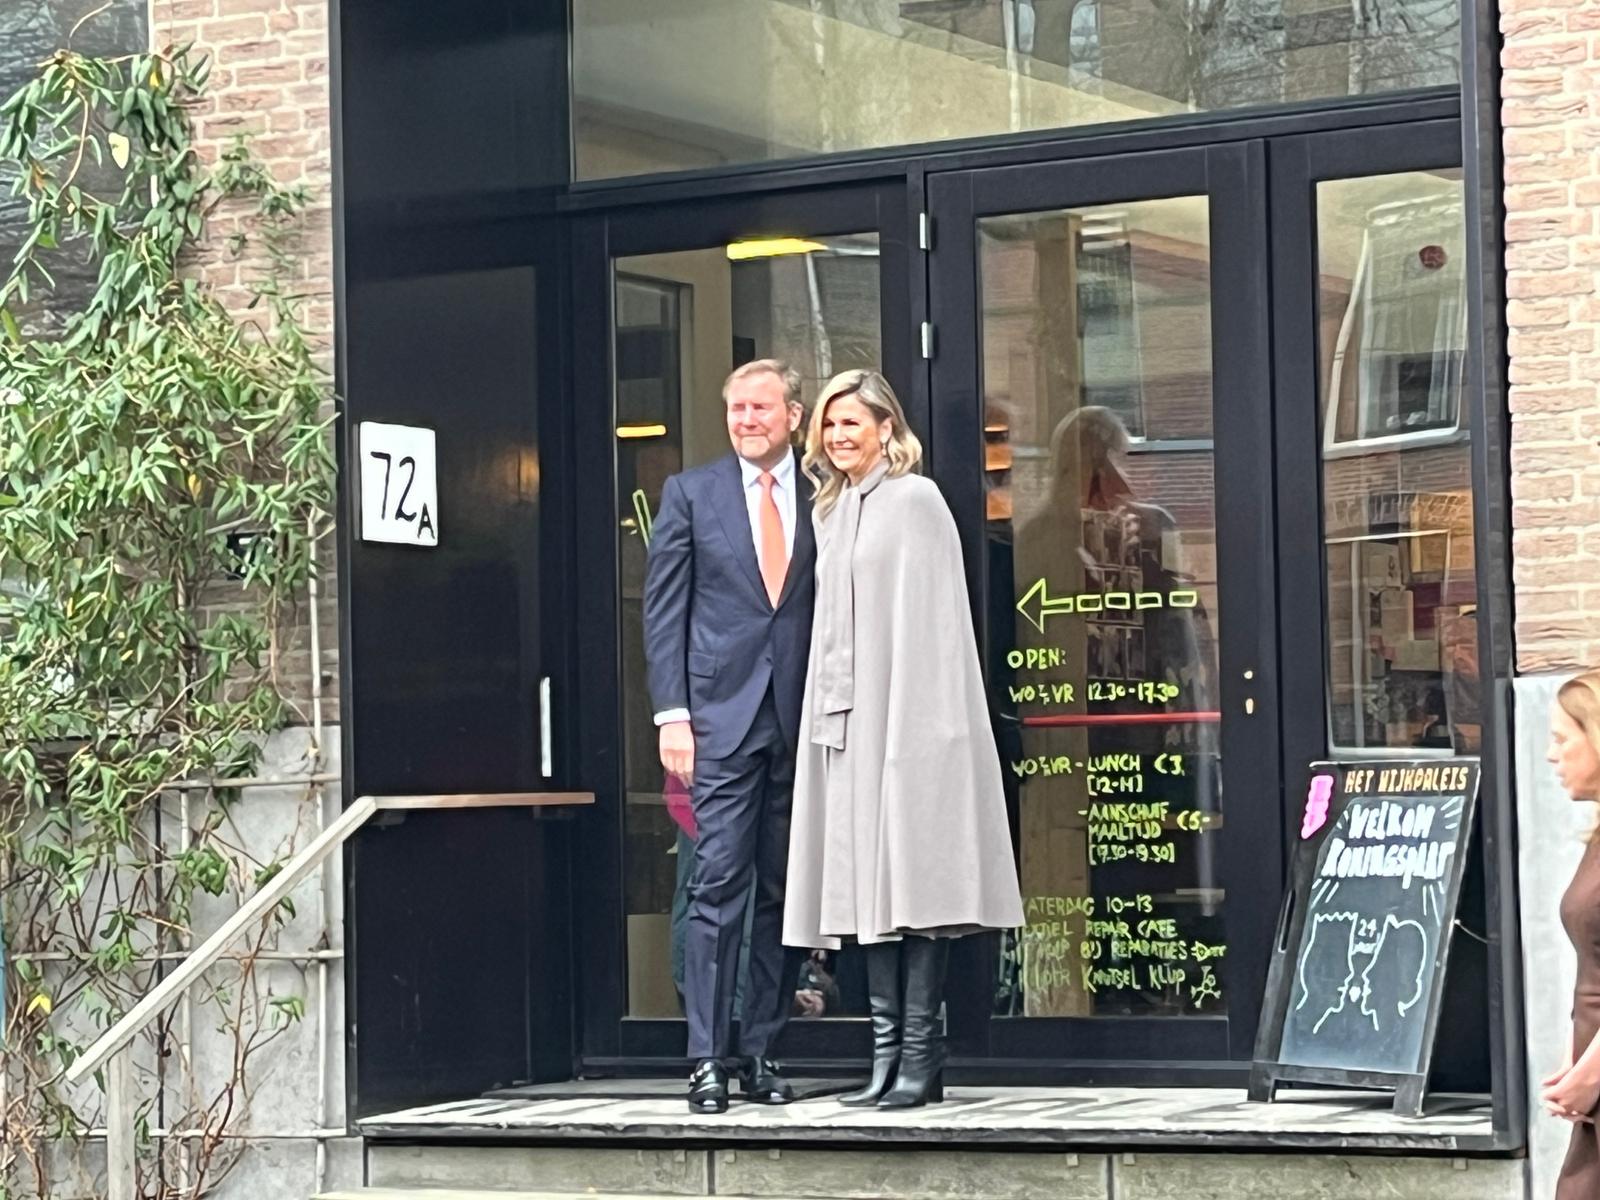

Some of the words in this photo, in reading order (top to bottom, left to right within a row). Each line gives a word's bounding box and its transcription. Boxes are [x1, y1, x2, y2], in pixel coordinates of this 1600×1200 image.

[370, 450, 435, 540] 72A
[1006, 647, 1067, 670] OPEN:
[1087, 753, 1141, 773] LUNCH
[1344, 769, 1375, 794] HET
[1348, 800, 1436, 840] WELKOM
[1025, 896, 1095, 916] ATERDAG
[1106, 893, 1154, 914] 10-13
